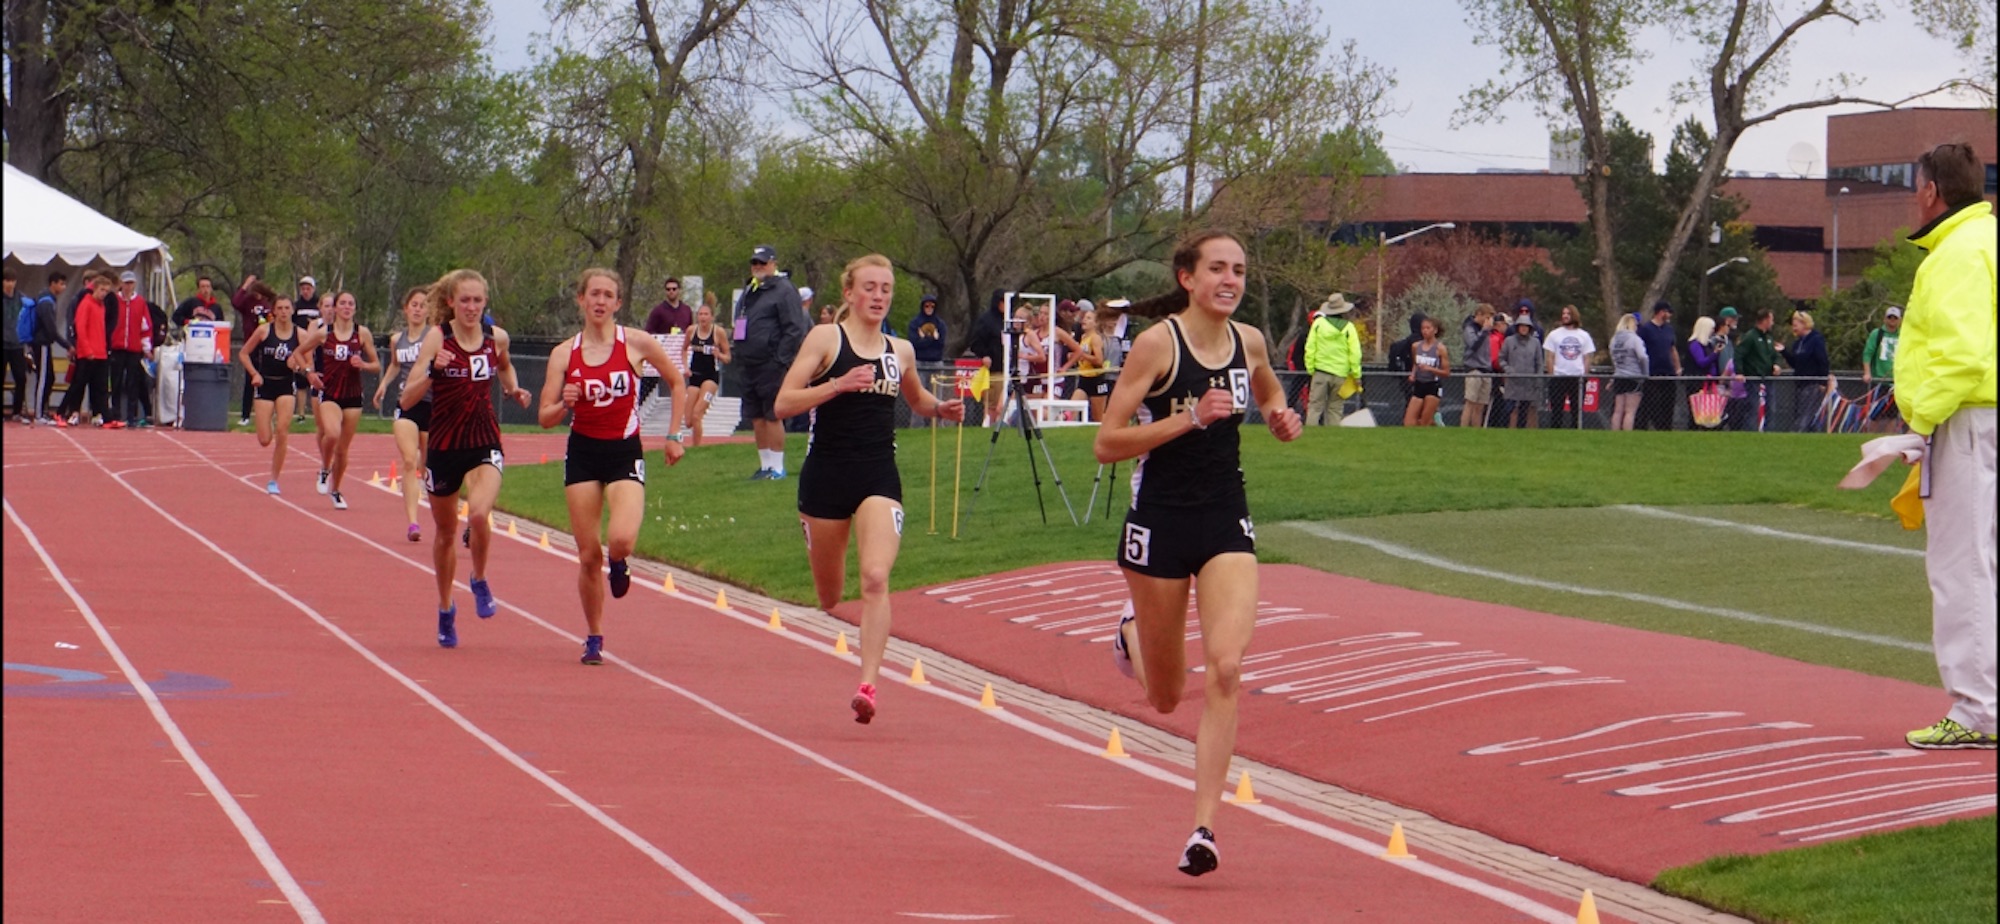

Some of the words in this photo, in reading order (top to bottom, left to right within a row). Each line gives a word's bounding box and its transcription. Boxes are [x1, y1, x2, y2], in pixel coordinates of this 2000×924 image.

[337, 346, 346, 360] 3
[472, 356, 487, 379] 2
[884, 355, 898, 379] 6
[613, 373, 626, 394] 4
[1233, 373, 1247, 405] 5
[1128, 528, 1143, 560] 5
